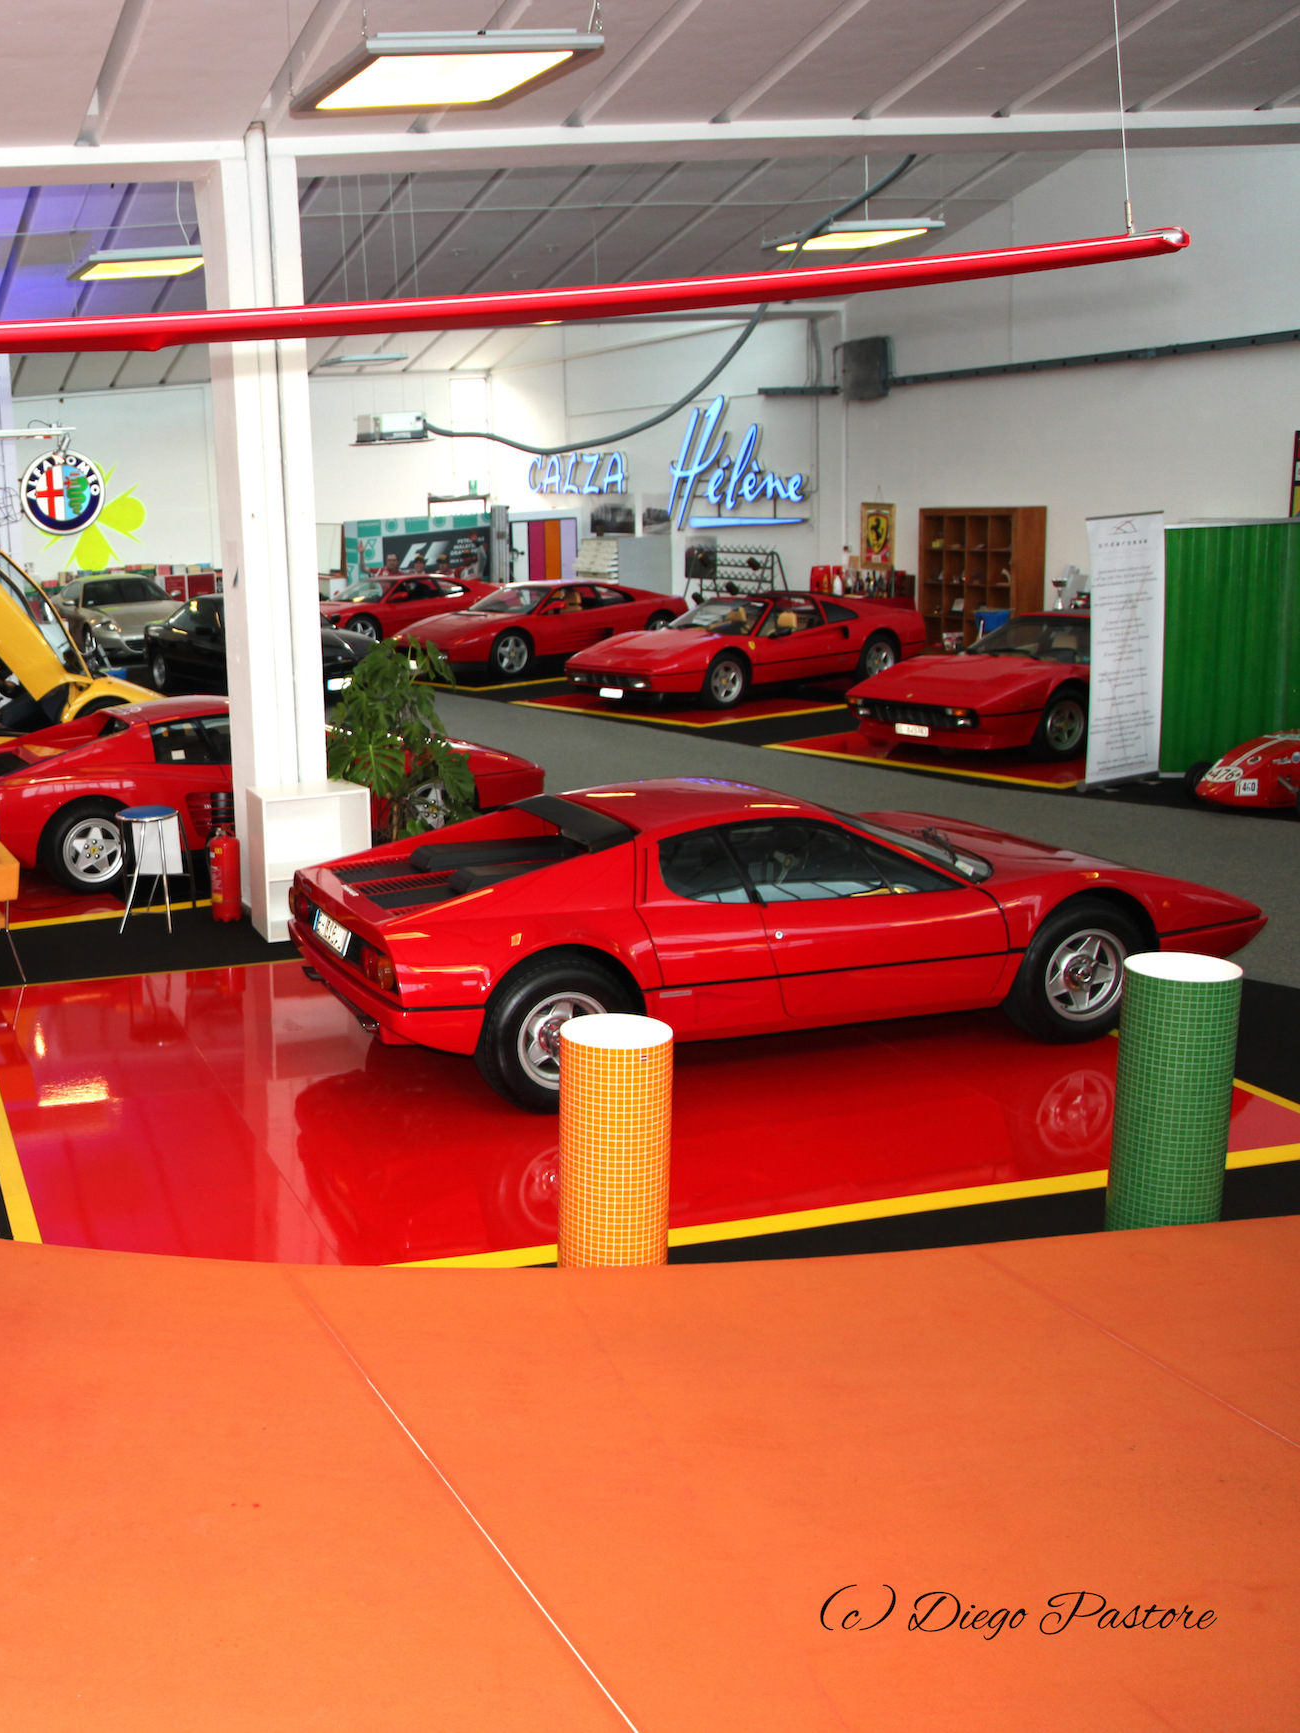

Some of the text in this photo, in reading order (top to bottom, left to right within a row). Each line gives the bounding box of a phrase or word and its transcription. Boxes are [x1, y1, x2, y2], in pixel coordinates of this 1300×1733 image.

[26, 460, 53, 500] ALFA
[528, 394, 805, 531] CALZA Hélène
